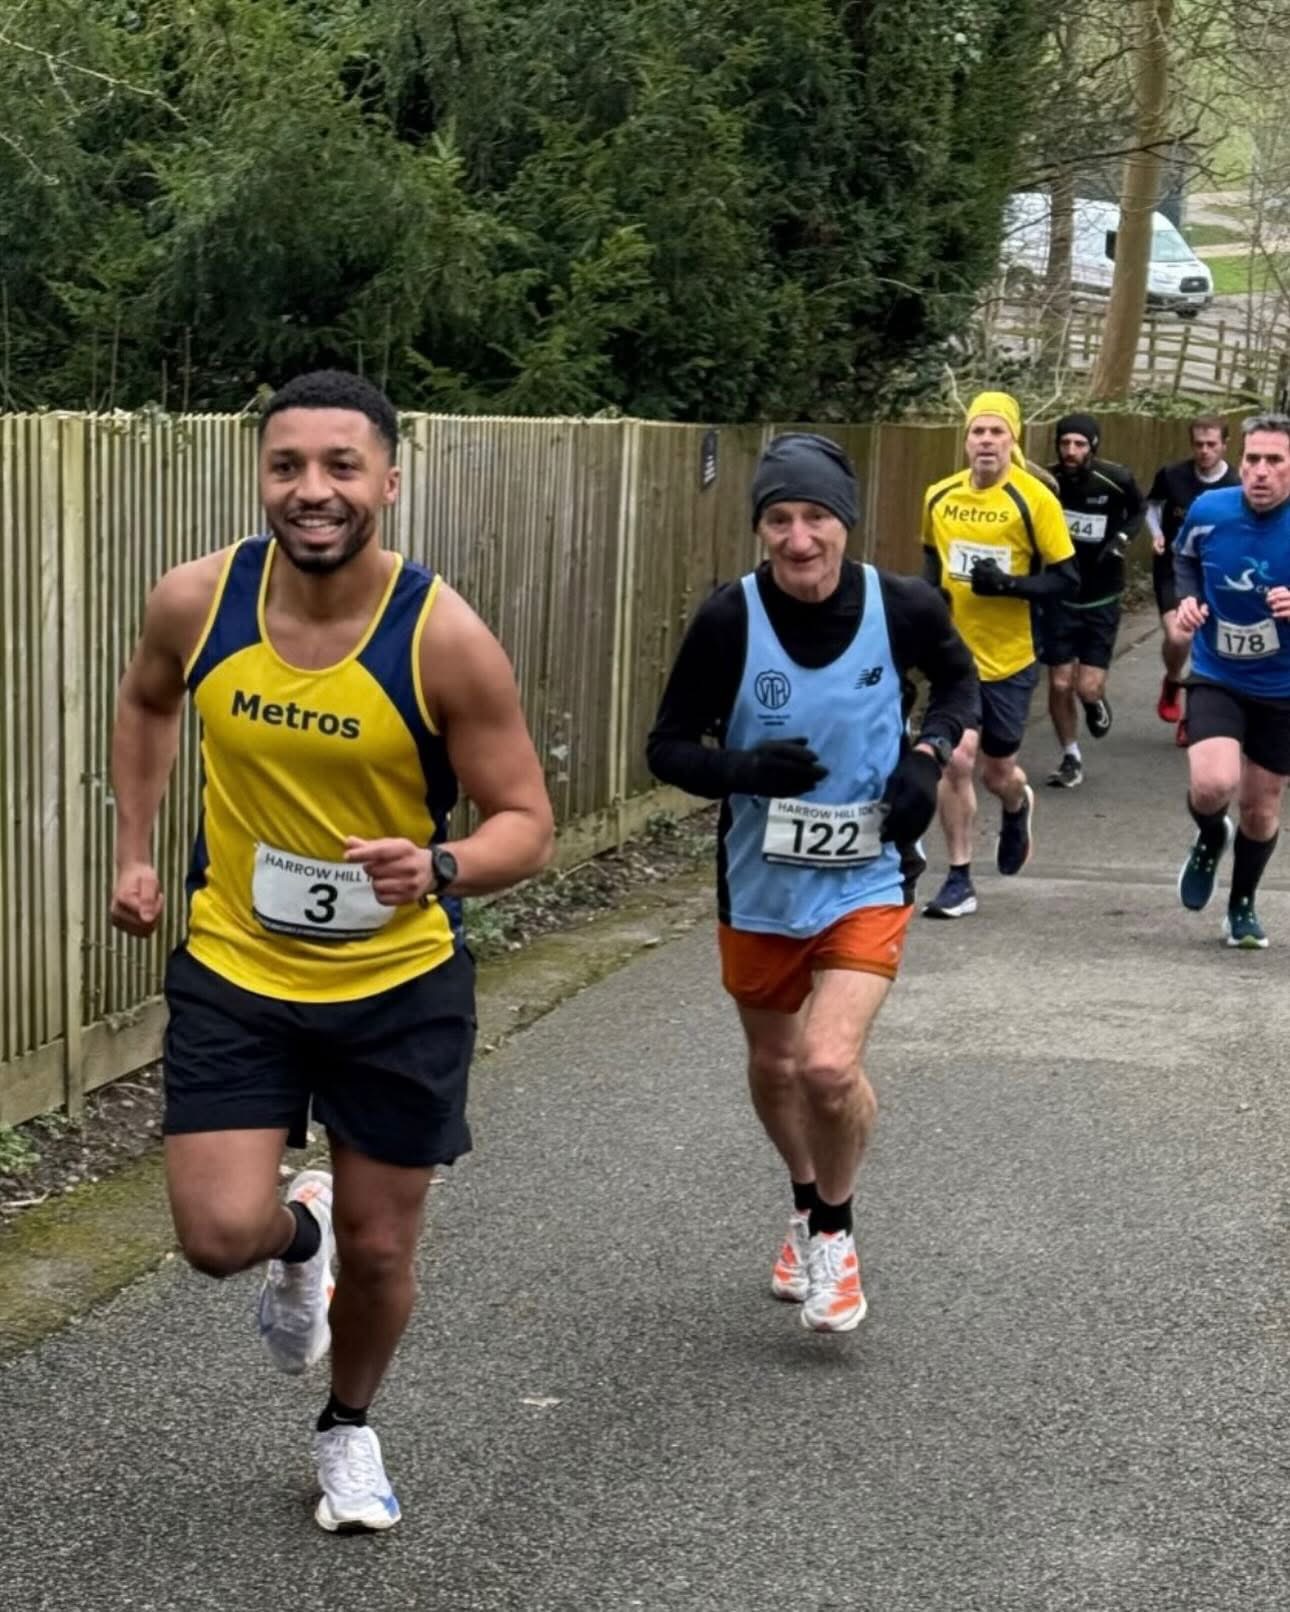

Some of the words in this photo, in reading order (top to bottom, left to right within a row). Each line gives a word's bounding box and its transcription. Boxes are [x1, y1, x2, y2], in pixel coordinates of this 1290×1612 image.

[943, 505, 1009, 523] Metros
[1224, 633, 1265, 653] 178
[231, 689, 360, 739] Metros
[778, 802, 832, 818] HARROW
[834, 809, 855, 819] HILL
[791, 818, 859, 856] 122
[265, 852, 332, 880] HARROW
[334, 869, 362, 882] HILL
[304, 883, 338, 924] 3
